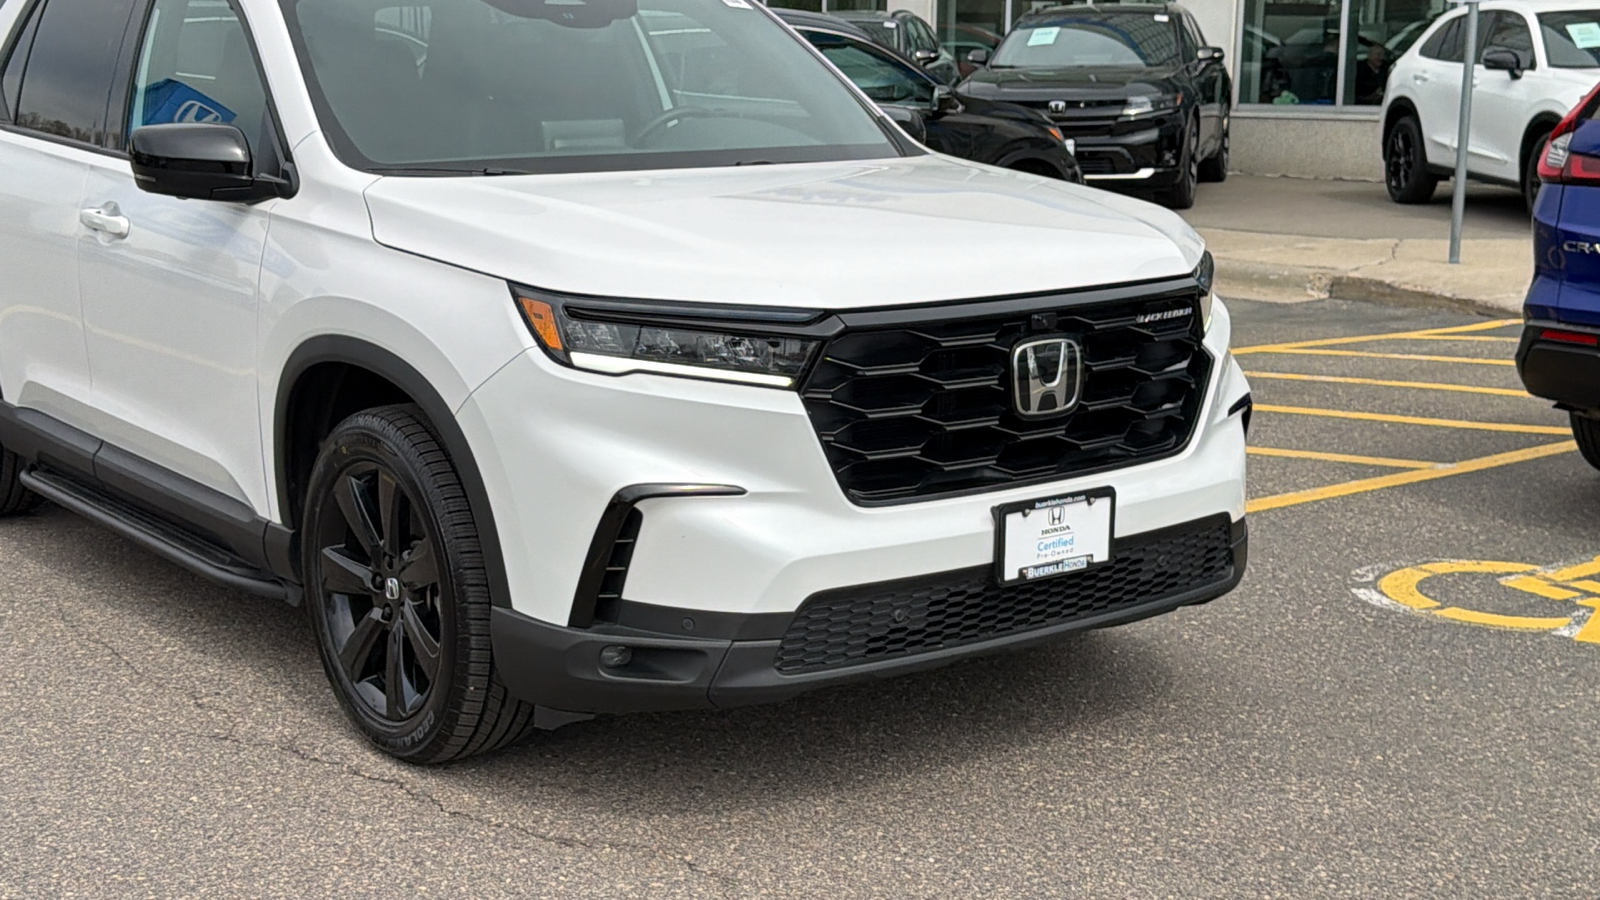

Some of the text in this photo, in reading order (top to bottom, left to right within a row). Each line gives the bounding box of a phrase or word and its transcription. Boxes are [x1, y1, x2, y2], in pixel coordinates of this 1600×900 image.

[1041, 525, 1071, 536] HONDA
[1037, 535, 1075, 552] Certified
[1036, 548, 1074, 559] Pre-Owned
